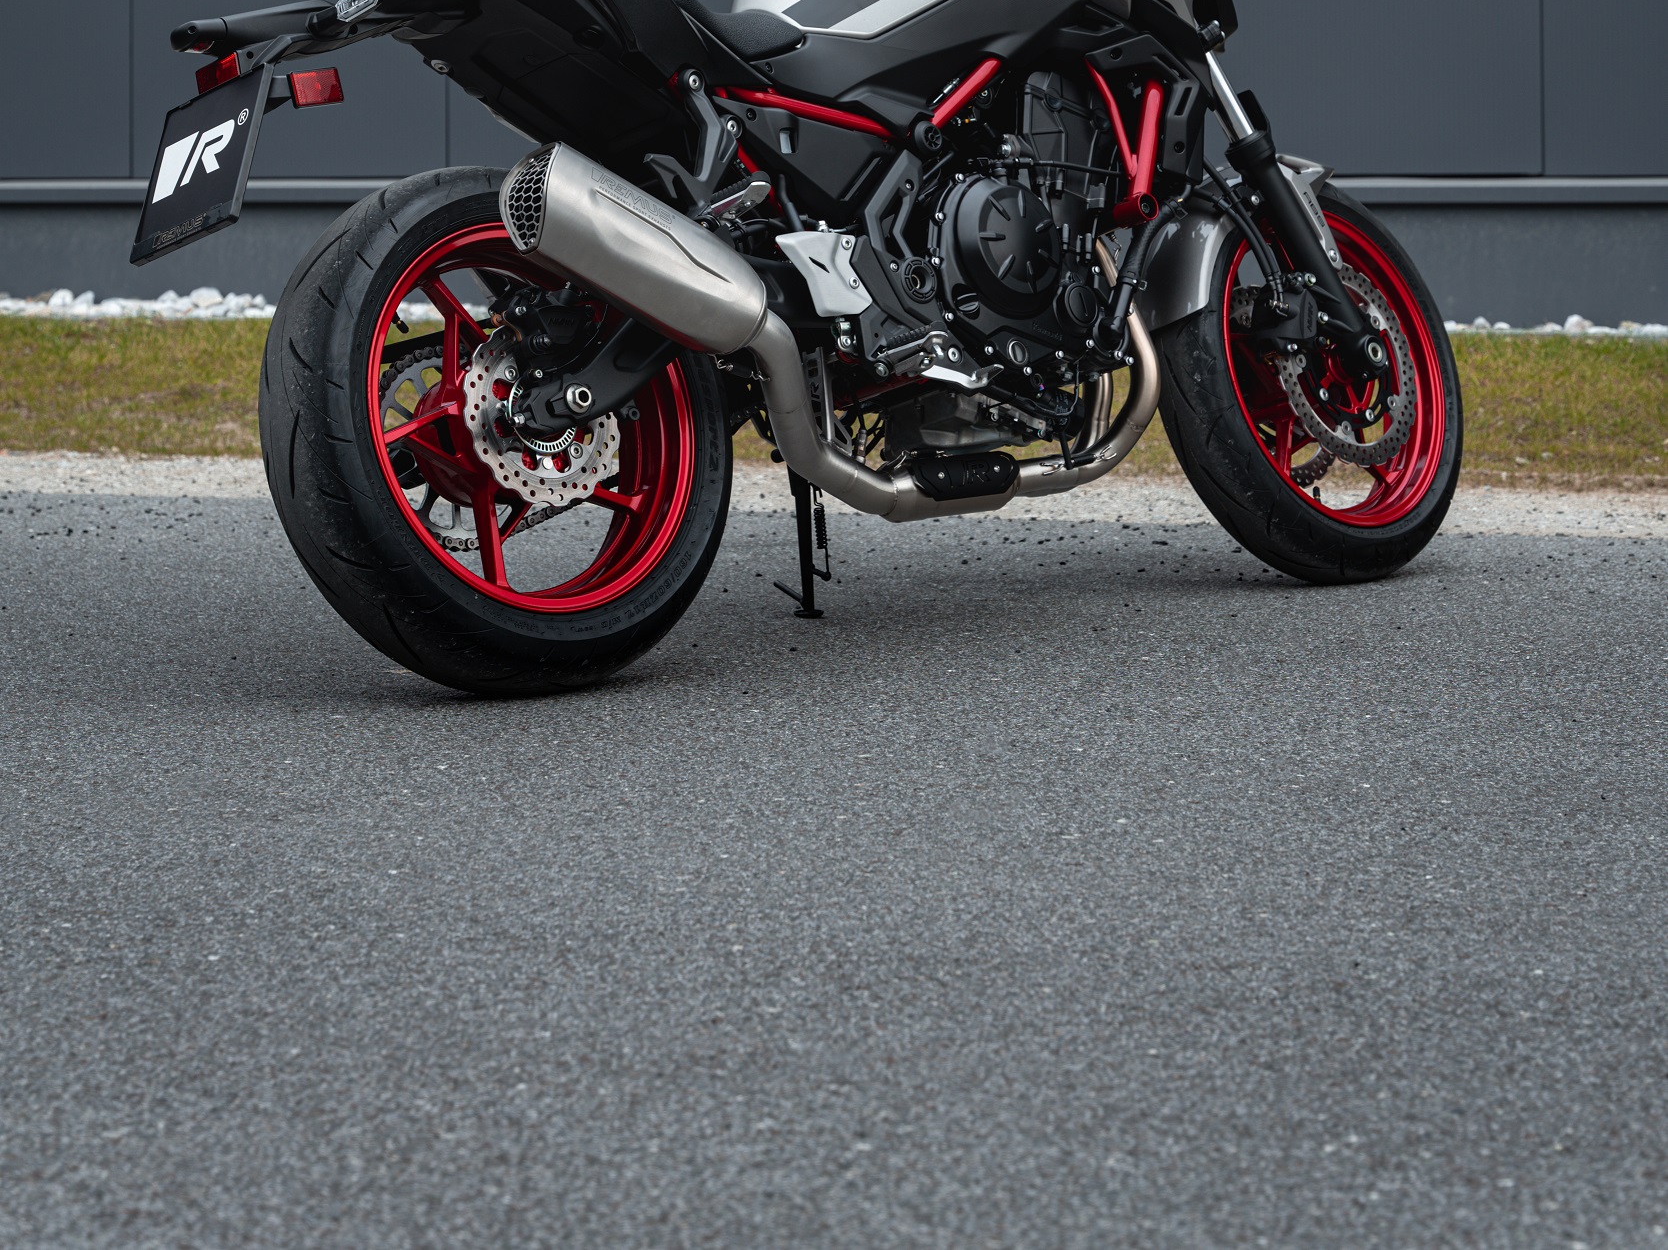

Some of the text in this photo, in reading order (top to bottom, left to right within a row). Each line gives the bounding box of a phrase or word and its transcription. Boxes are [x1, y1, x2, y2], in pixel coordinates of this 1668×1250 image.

[598, 186, 672, 231] PERFORMANCE SPORT EXHAUSTS
[601, 173, 673, 225] REMUS
